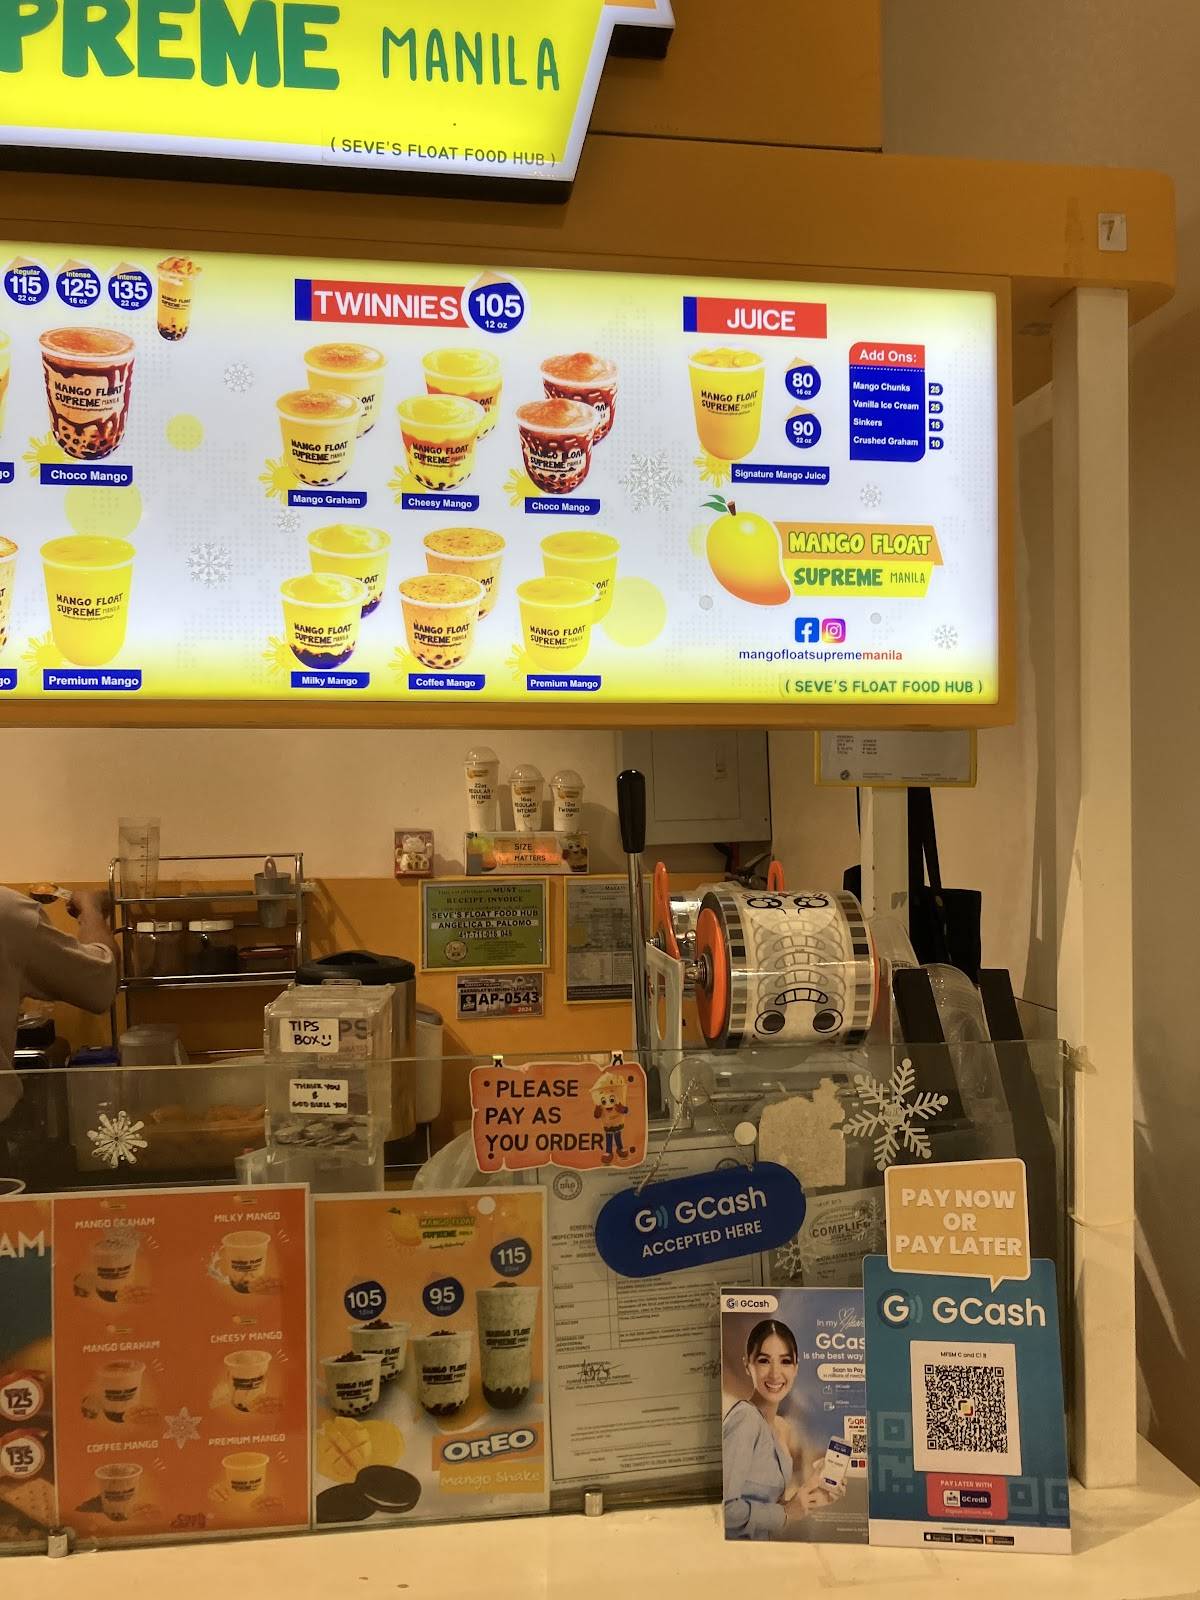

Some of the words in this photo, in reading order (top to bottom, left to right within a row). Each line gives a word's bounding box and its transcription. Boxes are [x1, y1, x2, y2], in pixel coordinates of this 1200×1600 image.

[381, 26, 561, 92] MANILA
[341, 138, 402, 158] SEVE'S
[408, 143, 458, 161] FLOAT
[464, 146, 508, 164] FOOD
[512, 149, 546, 167] HUB
[1101, 219, 1115, 241] 7
[13, 268, 40, 277] Regular
[66, 271, 91, 279] Intense
[117, 274, 142, 282] Intense
[10, 276, 42, 295] 115
[61, 278, 98, 297] 125
[111, 281, 148, 300] 135
[313, 290, 460, 321] TWINNIES
[475, 293, 522, 318] 105
[485, 320, 495, 328] 12
[727, 308, 796, 332] JUICE
[859, 350, 885, 362] Add
[888, 351, 917, 363] Ons:
[792, 372, 814, 388] 80
[54, 381, 92, 396] MANGO
[853, 382, 879, 392] Mango
[880, 383, 911, 392] Chunks
[930, 385, 941, 394] 25
[55, 393, 101, 407] SUPREME
[701, 389, 733, 402] MANGO
[736, 391, 758, 402] FLOAT
[701, 400, 740, 412] SUPREME
[853, 400, 880, 409] Vanilla
[881, 401, 890, 409] Ice
[891, 402, 919, 410] Cream
[792, 421, 814, 436] 90
[853, 418, 882, 427] Sinkers
[853, 436, 886, 446] Crushed
[888, 437, 919, 446] Graham
[931, 439, 941, 448] 10
[50, 469, 88, 481] Choco
[90, 470, 128, 482] Mango
[734, 469, 774, 480] Signature
[776, 470, 803, 481] Mango
[804, 471, 827, 481] Juice
[293, 495, 324, 506] Mango
[325, 495, 361, 506] Graham
[408, 498, 439, 510] Cheesy
[440, 499, 473, 510] Mango
[531, 501, 560, 512] Choco
[561, 502, 591, 513] Mango
[788, 531, 865, 554] MANGO
[871, 534, 932, 555] FLOAT
[793, 568, 883, 586] SUPREME
[890, 571, 926, 584] MANILA
[56, 593, 91, 606] MANGO
[96, 593, 124, 606] FLOAT
[57, 604, 101, 617] SUPREME
[530, 625, 560, 636] MANGO
[563, 625, 586, 636] FLOAT
[530, 634, 567, 646] SUPREME
[738, 649, 903, 663] mangofloatsuprememanila
[48, 675, 98, 686] Premium
[101, 676, 139, 687] Mango
[301, 676, 326, 687] Milky
[327, 676, 358, 688] Mango
[416, 678, 445, 688] Coffee
[446, 678, 476, 690] Mango
[530, 678, 568, 688] Premium
[569, 679, 598, 690] Mango
[795, 680, 848, 693] SEVE'S
[852, 681, 897, 693] FLOAT
[902, 681, 940, 693] FOOD
[945, 682, 973, 693] HUB
[514, 843, 533, 851] SIZE
[431, 911, 462, 920] SEVE'S
[464, 911, 491, 919] FLOAT
[494, 910, 518, 918] FOOD
[520, 909, 539, 917] HUB
[438, 921, 483, 929] ANGELICA
[496, 919, 532, 927] PALOMO
[478, 992, 540, 1006] AP-0543
[288, 1020, 320, 1032] TIPS
[294, 1034, 320, 1046] BOX
[496, 1080, 579, 1098] PLEASE
[485, 1107, 525, 1125] PAY
[532, 1107, 562, 1124] AS
[485, 1133, 530, 1152] YOU
[536, 1132, 603, 1152] ORDER
[902, 1188, 952, 1208] PAY
[956, 1189, 1017, 1210] NOW
[674, 1186, 767, 1229] GCash
[214, 1213, 244, 1222] MILKY
[246, 1212, 281, 1222] MANGO
[942, 1213, 977, 1232] OR
[75, 1219, 111, 1230] MANGO
[641, 1230, 722, 1259] ACCEPTED
[725, 1220, 763, 1241] HERE
[895, 1235, 947, 1255] PAY
[950, 1236, 1023, 1257] LATER
[497, 1246, 527, 1265] 115
[347, 1289, 382, 1309] 105
[428, 1286, 456, 1305] 95
[740, 1298, 770, 1308] GCash
[932, 1296, 1046, 1327] GCash
[816, 1319, 824, 1327] In
[825, 1320, 838, 1329] my
[210, 1333, 247, 1344] CHEESY
[248, 1331, 283, 1342] MANGO
[83, 1343, 118, 1353] MANGO
[119, 1340, 161, 1352] GRAHAM
[811, 1352, 826, 1360] the
[827, 1352, 845, 1360] best
[846, 1353, 864, 1362] way
[208, 1437, 251, 1446] PREMIUM
[252, 1433, 286, 1444] MANGO
[443, 1429, 535, 1461] OREO
[87, 1443, 122, 1453] COFFEE
[123, 1440, 159, 1451] MANGO
[954, 1480, 973, 1488] LATER
